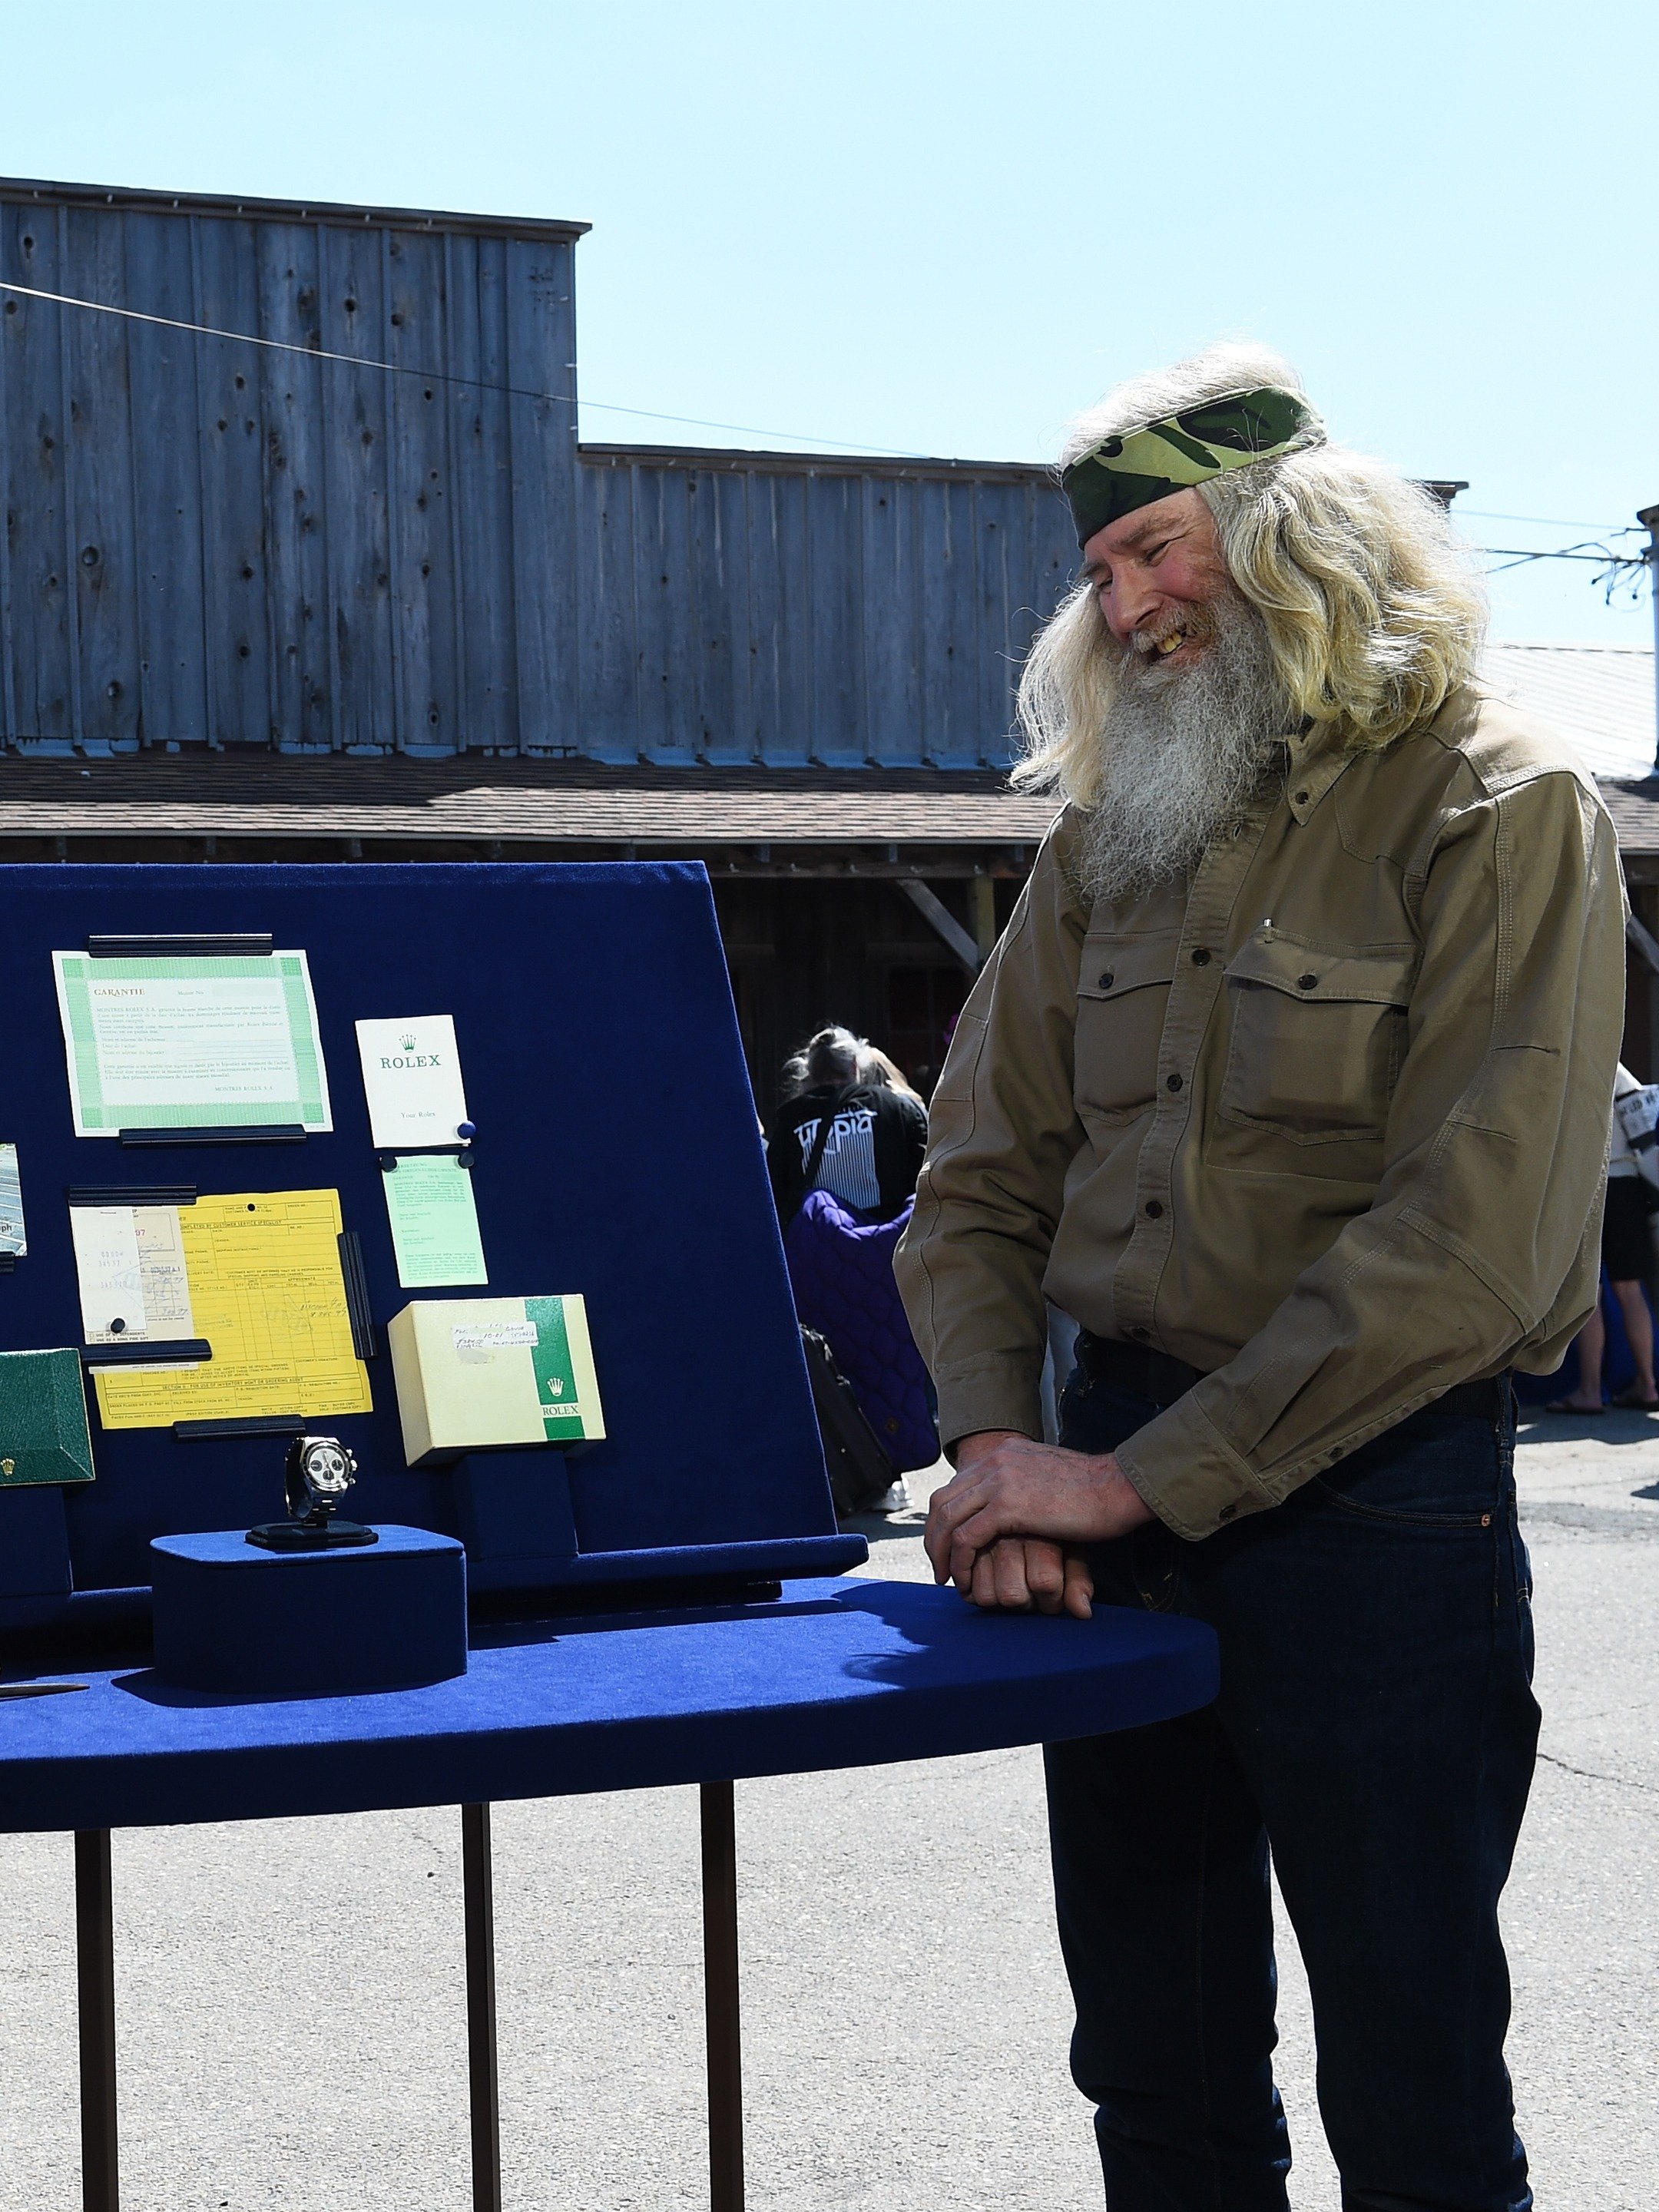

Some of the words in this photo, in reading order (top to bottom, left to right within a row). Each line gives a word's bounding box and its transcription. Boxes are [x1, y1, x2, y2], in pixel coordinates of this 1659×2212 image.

[94, 988, 145, 997] GARANTIE
[380, 1055, 442, 1069] ROLEX
[0, 1224, 12, 1233] ph
[542, 1406, 578, 1416] ROLEX
